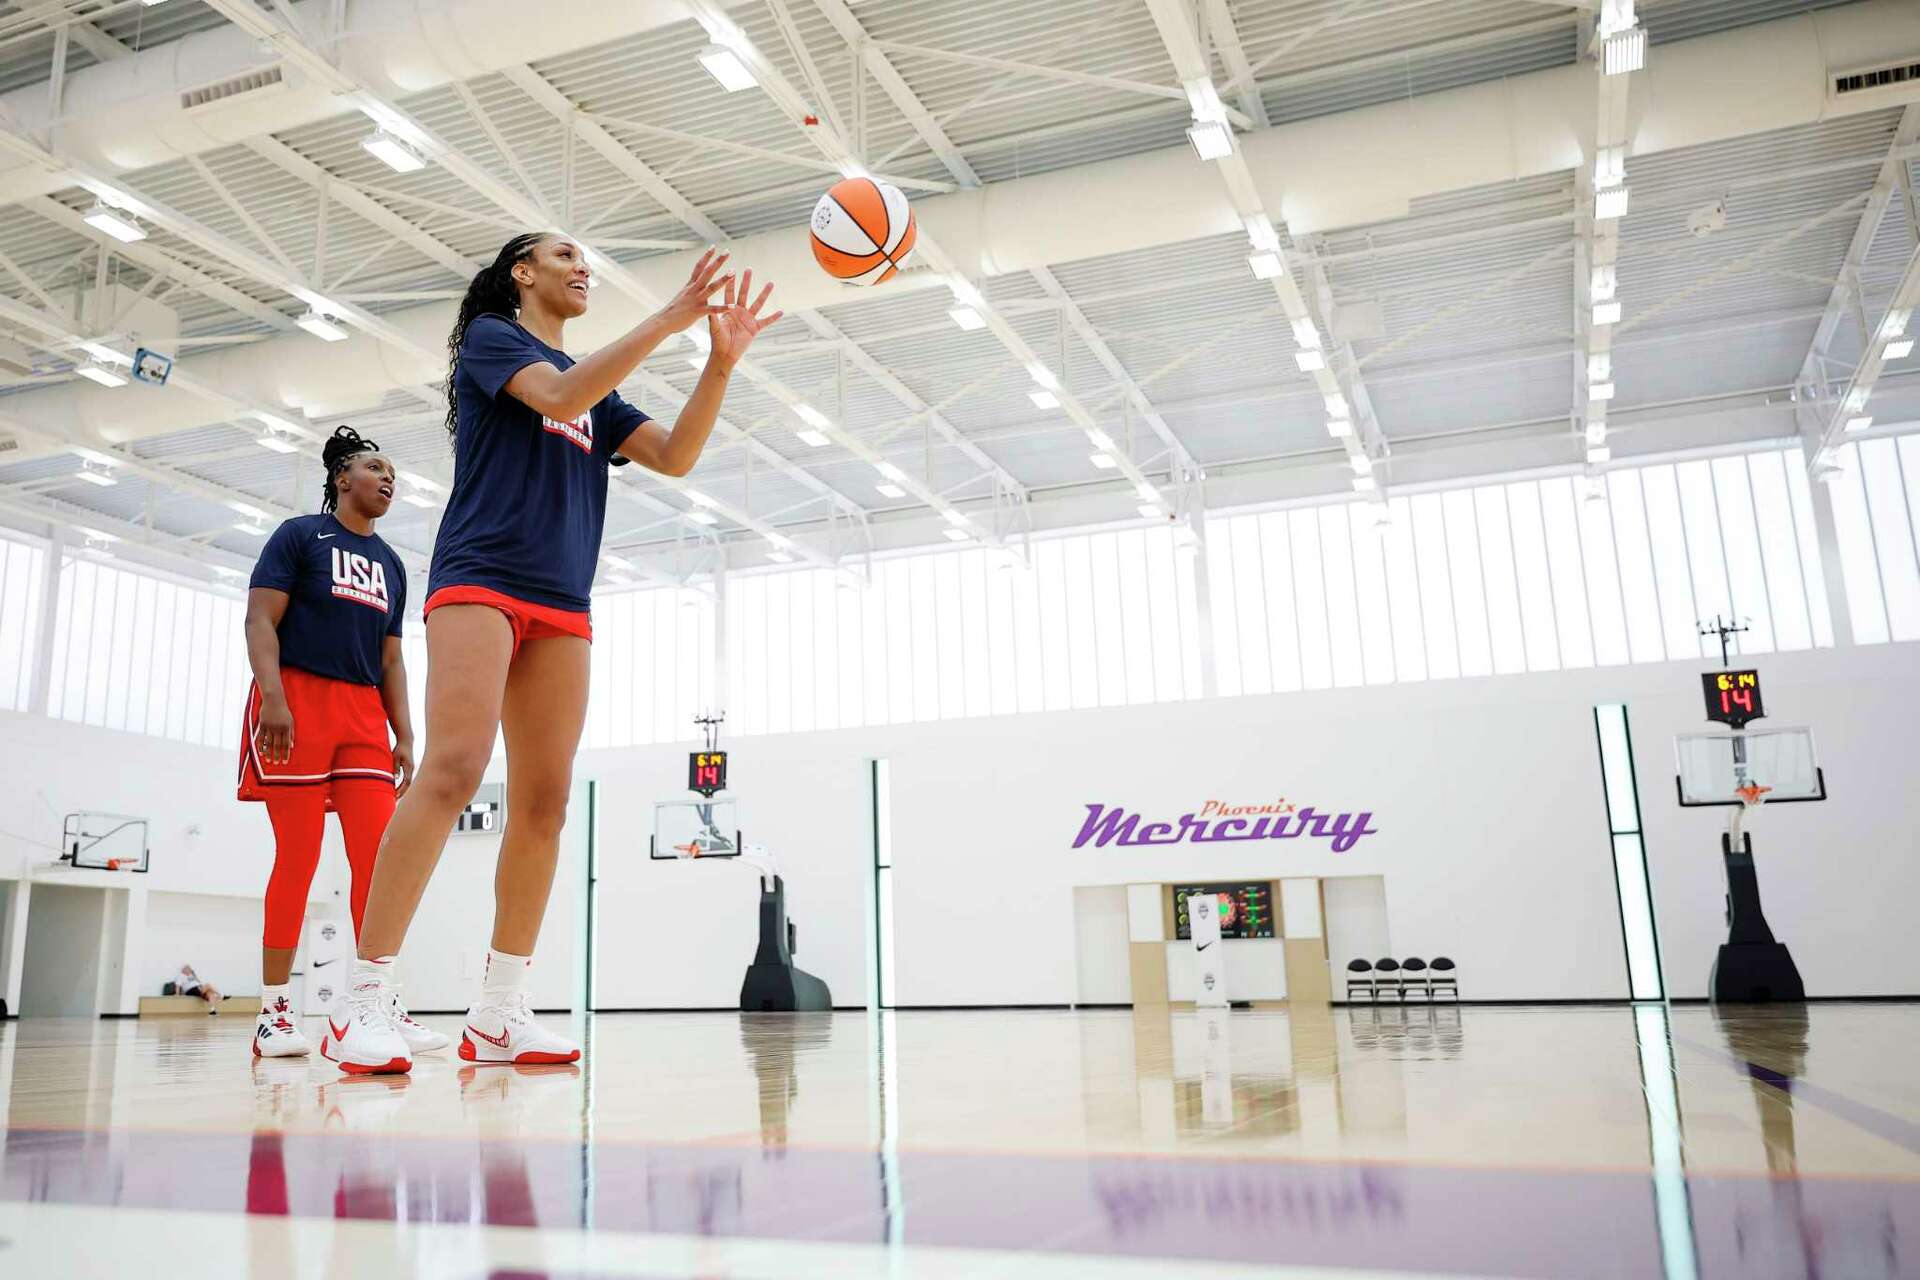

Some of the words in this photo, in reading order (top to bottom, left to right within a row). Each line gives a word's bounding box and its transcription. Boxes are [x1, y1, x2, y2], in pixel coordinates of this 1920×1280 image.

[332, 546, 389, 601] USA
[1717, 673, 1755, 690] 6:14
[1721, 689, 1752, 714] 14
[698, 767, 717, 785] 14
[1200, 797, 1296, 817] Phoenix
[1071, 803, 1379, 853] Mercury
